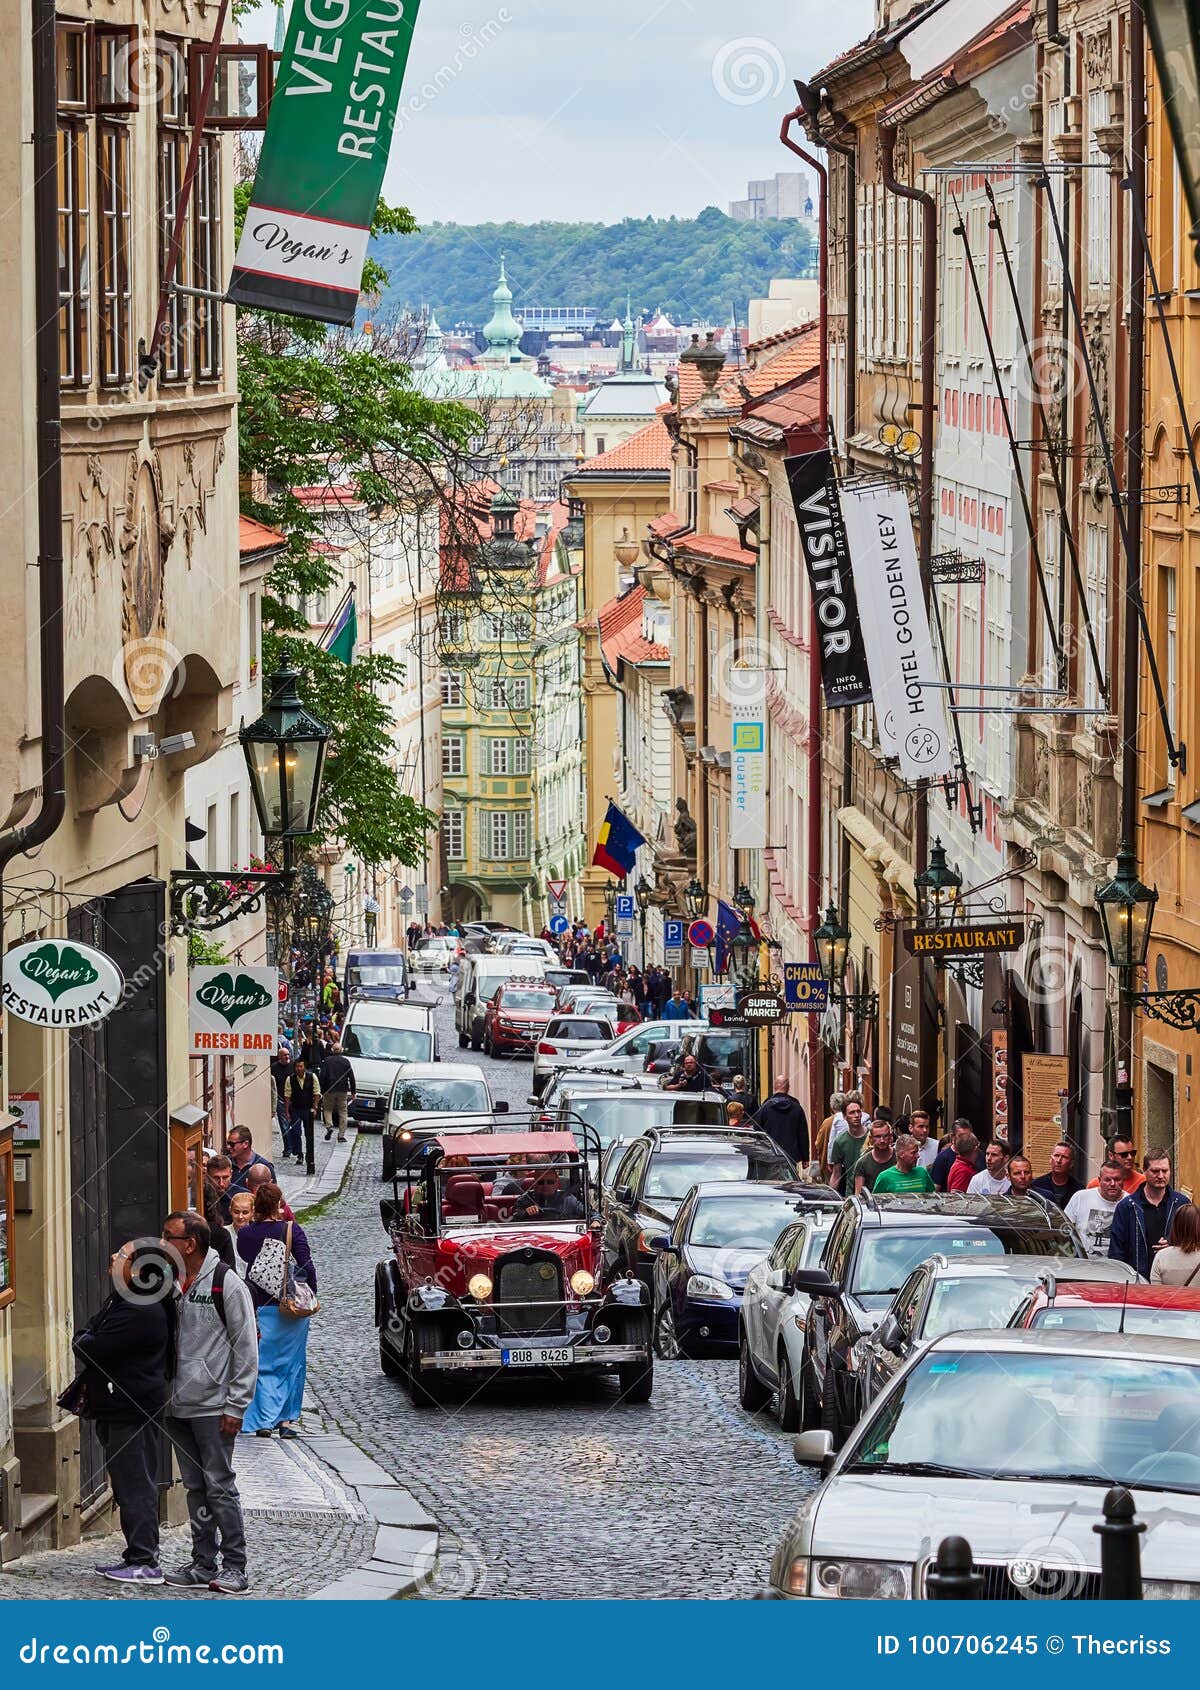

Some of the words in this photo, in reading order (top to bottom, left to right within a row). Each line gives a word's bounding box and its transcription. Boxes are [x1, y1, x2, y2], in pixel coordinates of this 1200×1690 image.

[829, 503, 846, 557] PRAGUE
[876, 512, 898, 551] KEY
[799, 486, 852, 660] VISITOR
[884, 557, 913, 645] GOLDEN
[831, 682, 864, 694] CENTRE
[835, 674, 857, 685] INFO
[900, 649, 926, 715] HOTEL
[734, 756, 748, 812] quarter
[667, 924, 679, 939] P
[913, 929, 1017, 950] RESTAURANT
[24, 957, 94, 985] Vegan's
[200, 985, 268, 1011] Vegan's
[748, 998, 778, 1008] SUPER
[743, 1007, 782, 1017] MARKET
[194, 1032, 240, 1049] FRESH
[243, 1033, 273, 1050] BAR
[511, 1350, 533, 1363] 8U8
[540, 1349, 569, 1362] 8426
